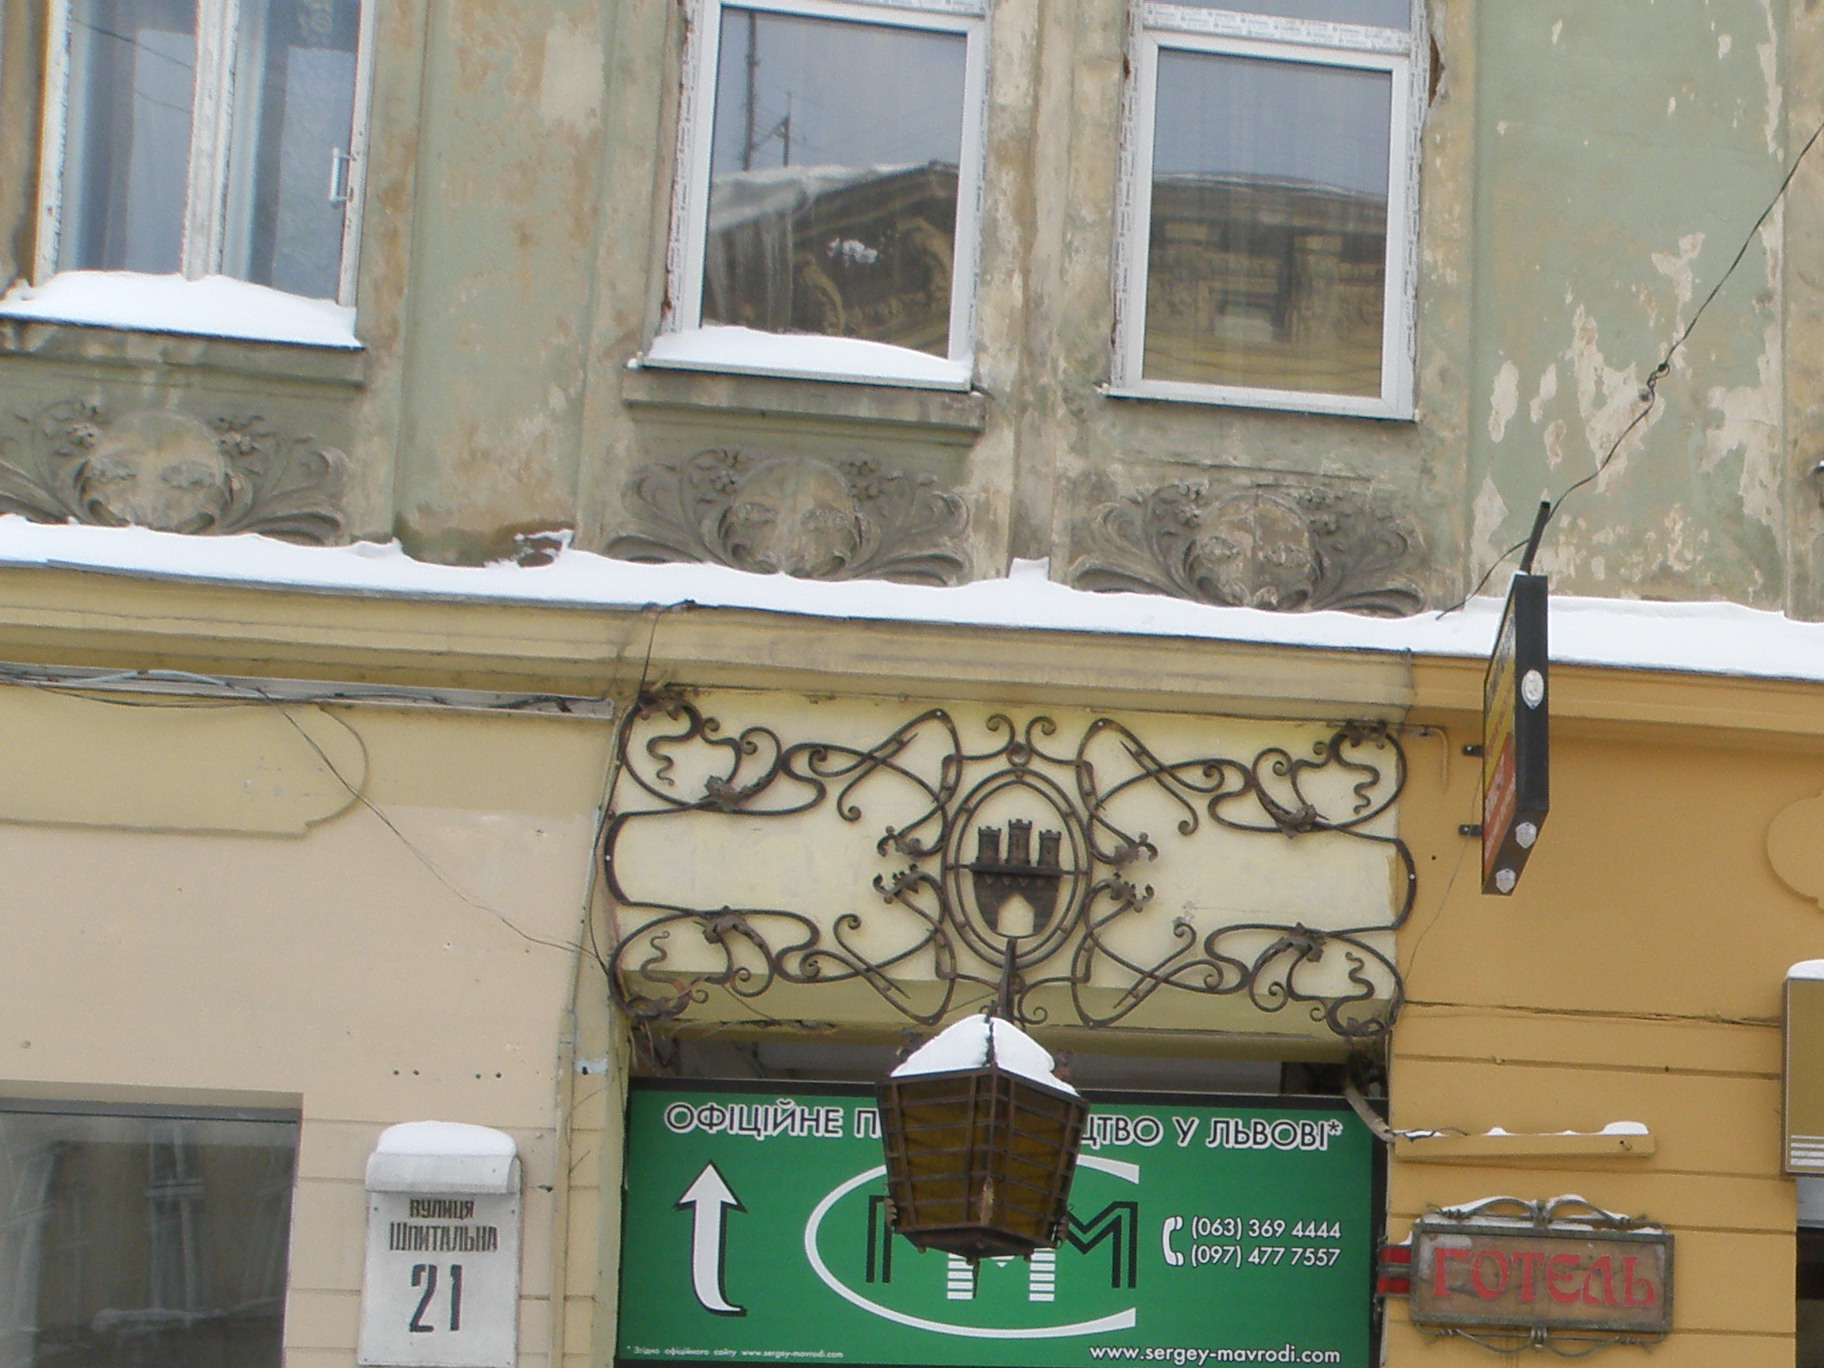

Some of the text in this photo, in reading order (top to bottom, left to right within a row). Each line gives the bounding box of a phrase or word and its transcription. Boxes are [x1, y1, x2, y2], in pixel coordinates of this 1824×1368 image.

[664, 1098, 844, 1141] ОФІЦІЙНЕ
[1173, 1116, 1200, 1147] У
[390, 1222, 498, 1251] ШПИТАЛЬНА
[1191, 1216, 1342, 1240] (063) 369 4444
[1190, 1244, 1342, 1268] (097) 477 7557
[1432, 1247, 1656, 1306] ГОТЕЛЬ
[409, 1264, 463, 1333] 21
[1089, 1344, 1342, 1366] www.sergey-mavrodi.com
